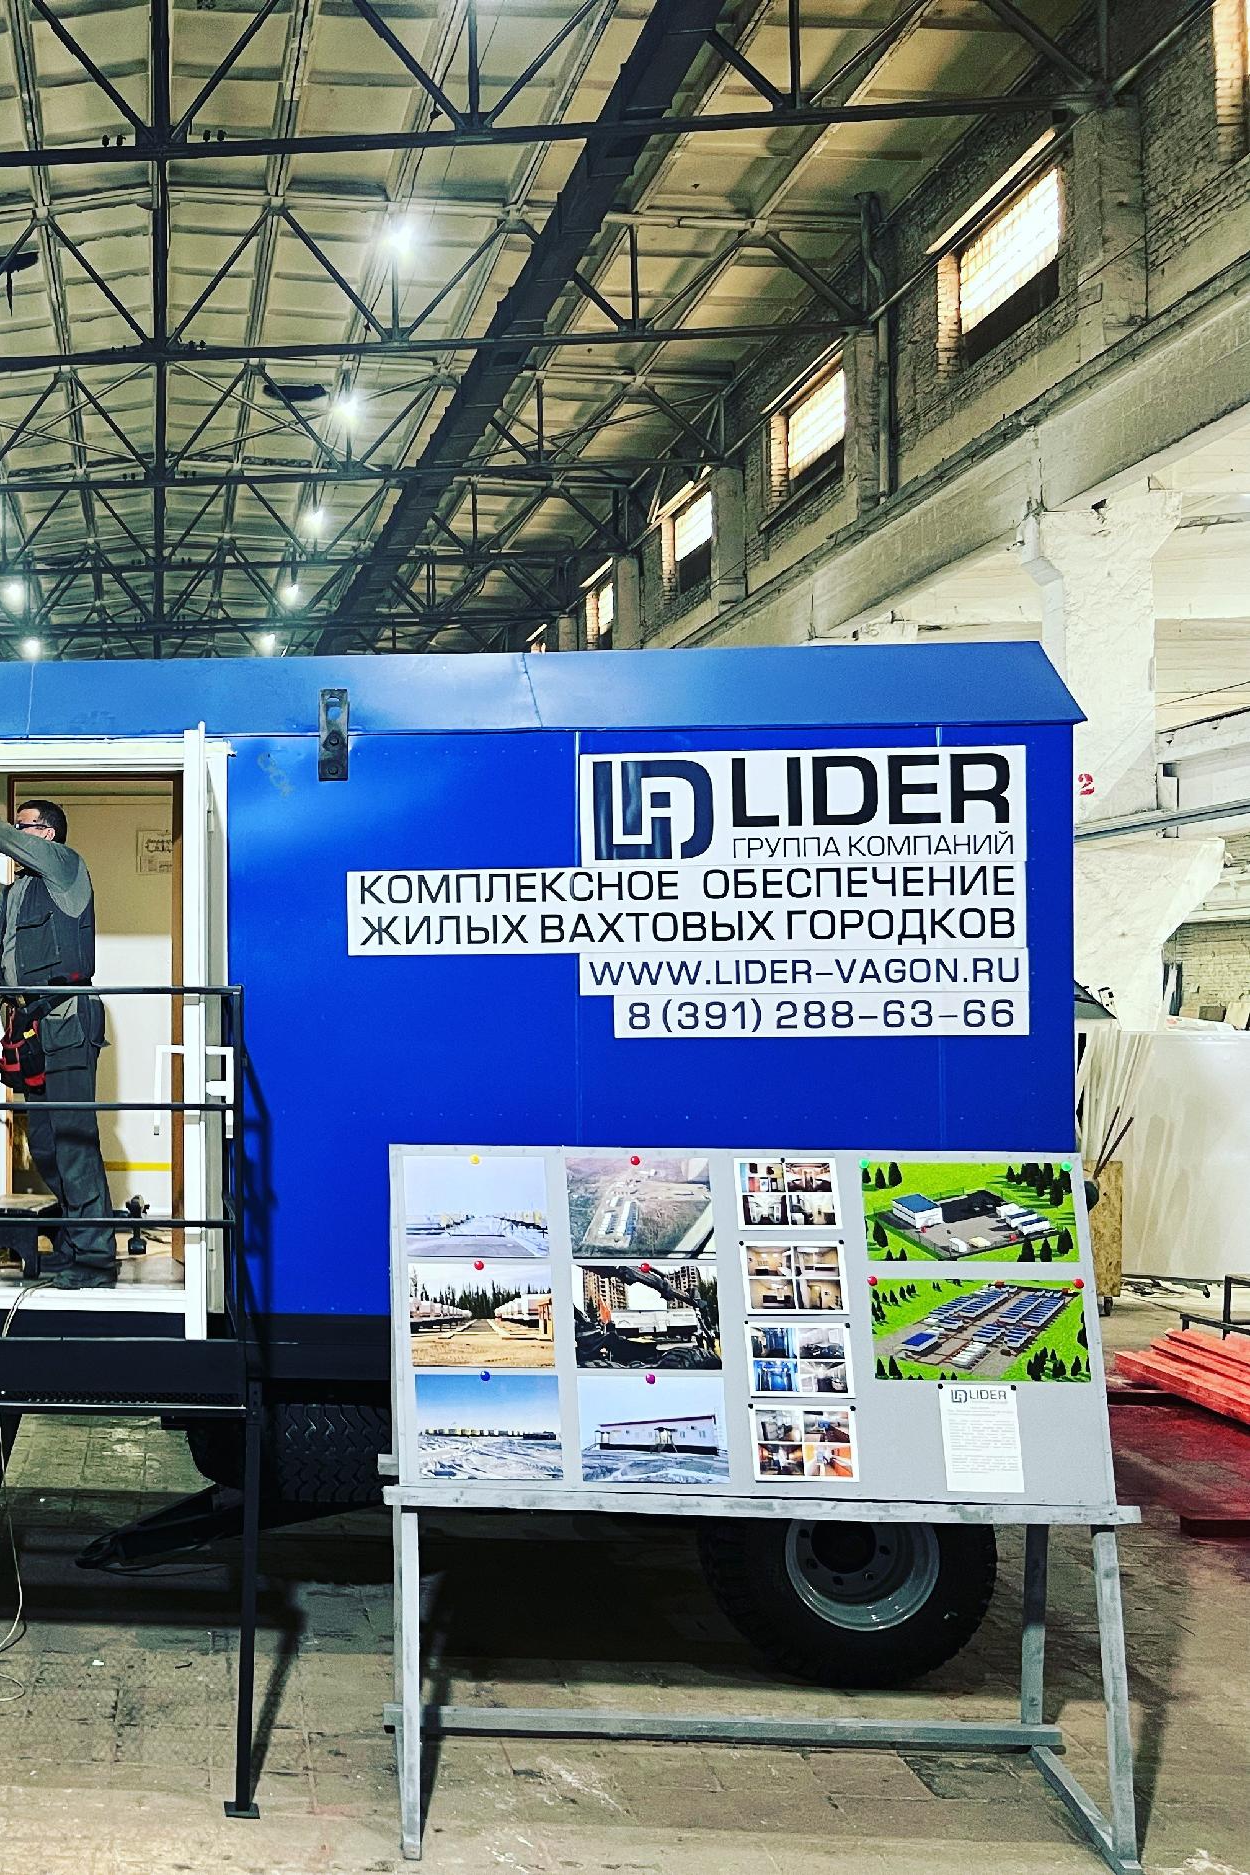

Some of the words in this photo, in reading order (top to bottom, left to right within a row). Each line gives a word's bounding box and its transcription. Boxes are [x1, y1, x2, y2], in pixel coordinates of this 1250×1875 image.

[731, 752, 1011, 828] LIDER
[1077, 773, 1095, 796] 2
[733, 836, 841, 859] ГРУППА
[848, 831, 1014, 857] КОМПАНИЙ
[359, 870, 679, 905] КОМПЛЕКСНОЕ
[703, 865, 1015, 900] ОБЕСПЕЧЕНИЕ
[360, 914, 528, 946] ЖИЛЫХ
[540, 910, 775, 944] ВАХТОВЫХ
[787, 907, 1015, 945] ГОРОДКОВ
[588, 957, 1020, 986] WWW.LIDER-VAGON.RU
